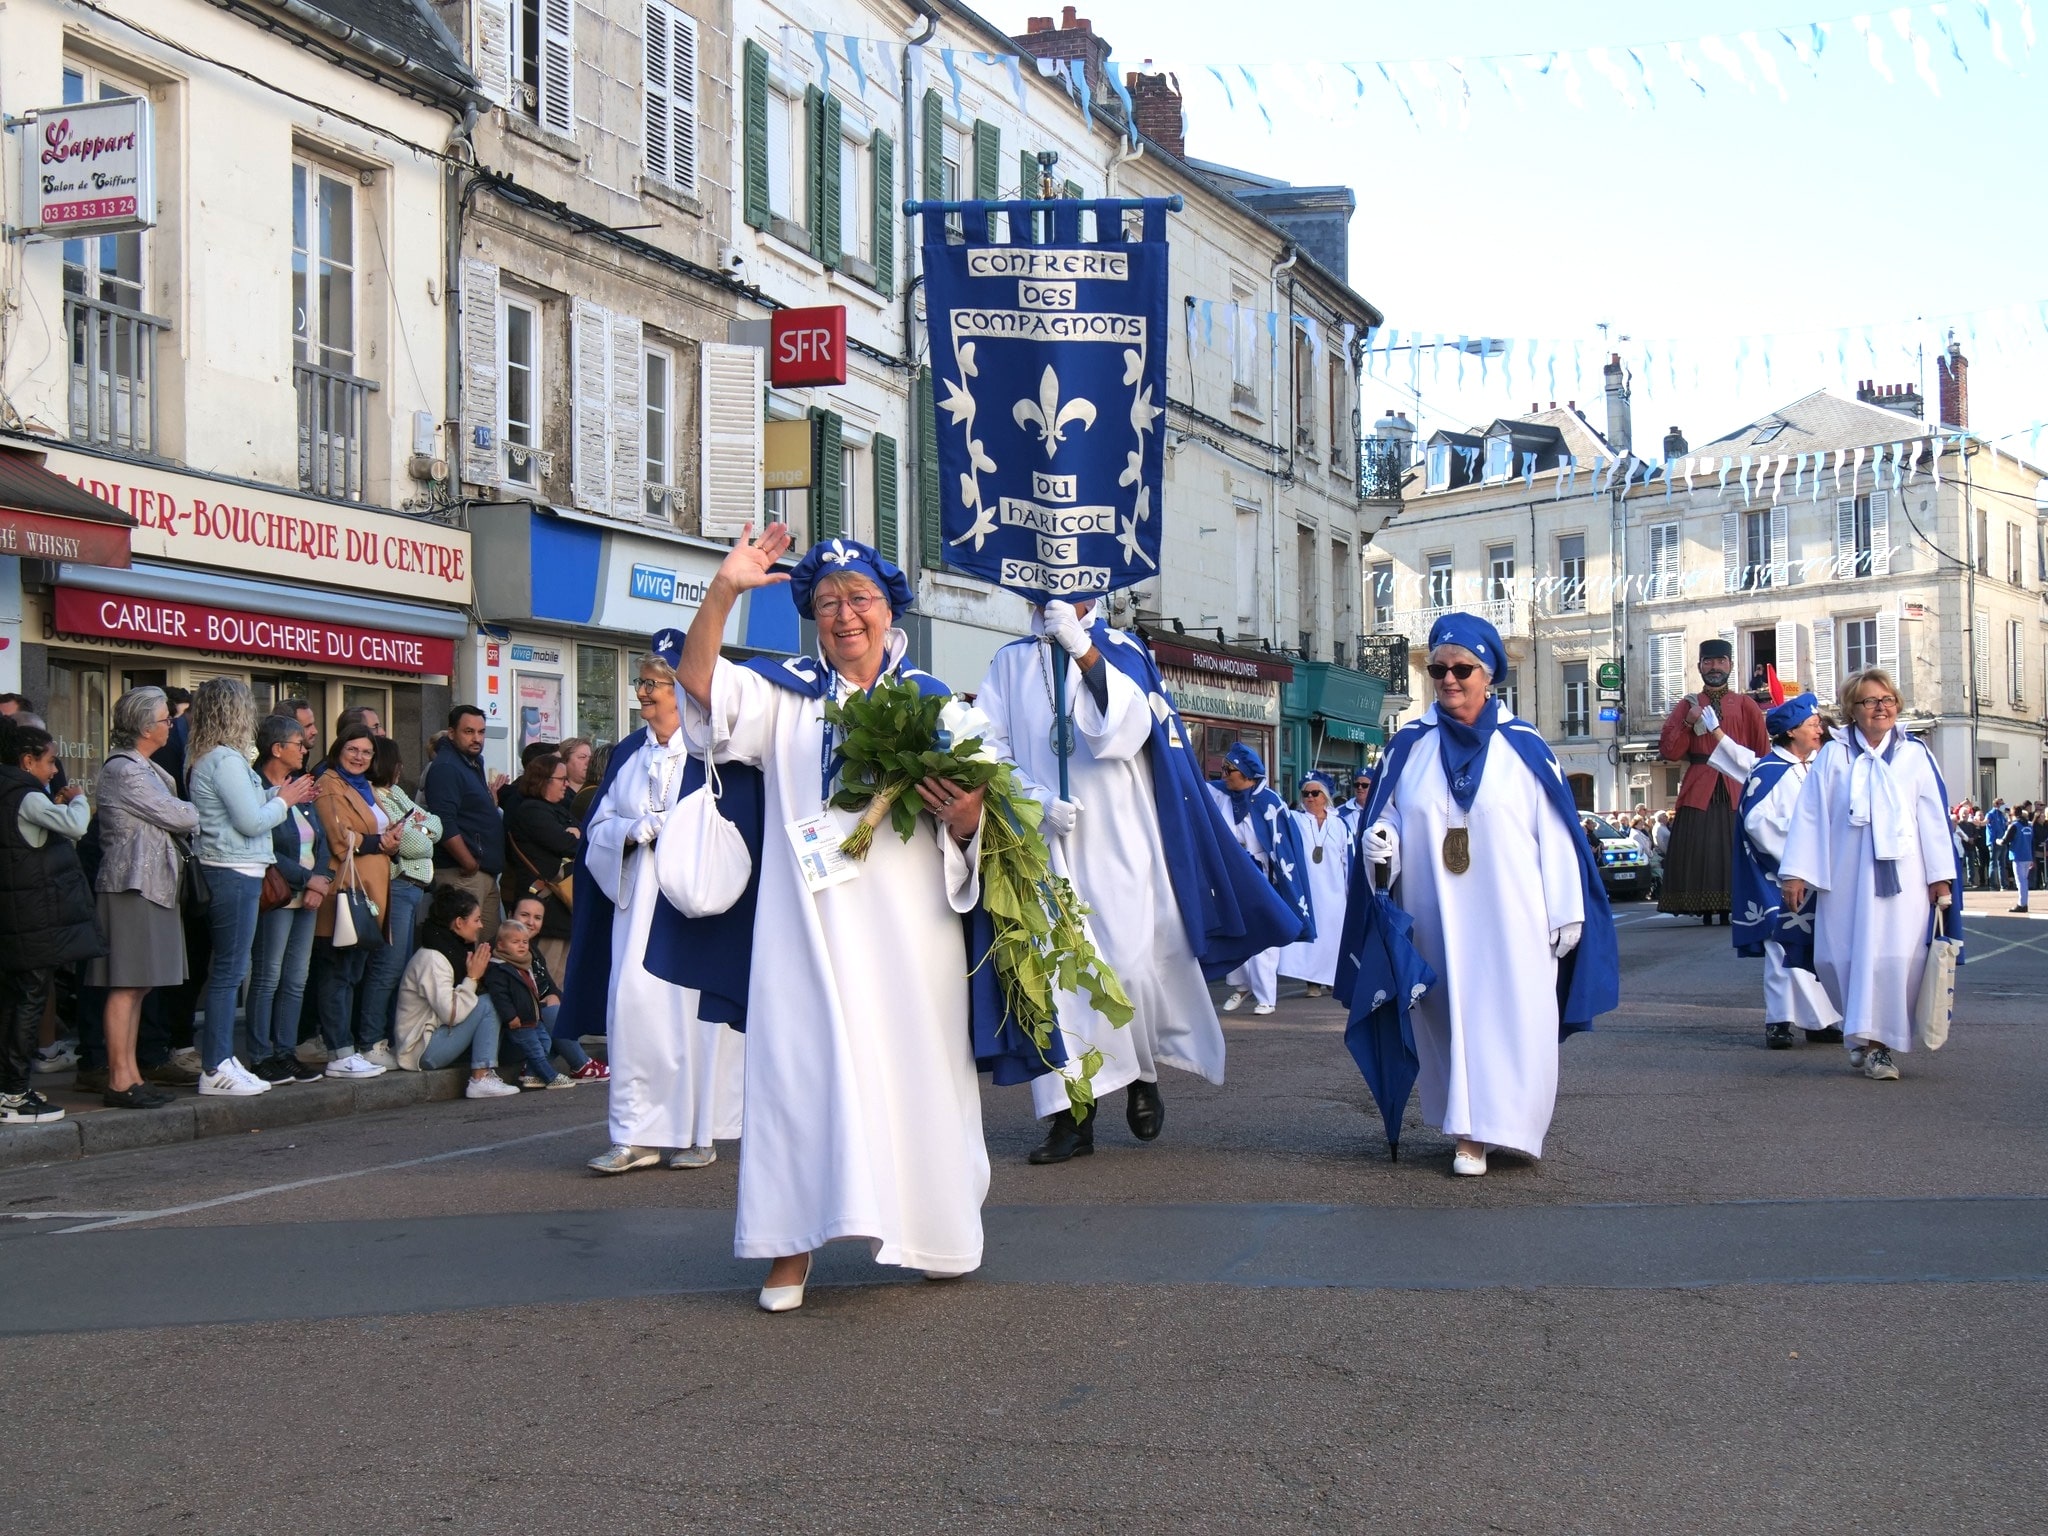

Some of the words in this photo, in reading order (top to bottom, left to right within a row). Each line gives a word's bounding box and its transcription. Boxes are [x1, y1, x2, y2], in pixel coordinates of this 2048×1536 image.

[42, 175, 74, 195] Salon
[78, 180, 89, 190] de
[44, 207, 59, 220] 03
[63, 205, 77, 218] 23
[82, 203, 96, 216] 53
[101, 201, 115, 214] 13
[120, 199, 134, 212] 24
[1023, 284, 1072, 306] DES
[954, 311, 1142, 336] COMPAGNONS
[779, 328, 831, 363] SFR
[764, 469, 803, 485] ange
[1036, 477, 1073, 498] DU
[25, 530, 81, 558] WHISKY
[1041, 538, 1071, 559] DE
[345, 528, 379, 565] DU
[384, 536, 465, 582] CENTRE
[636, 570, 672, 597] vivre
[676, 581, 708, 603] mob
[1005, 562, 1108, 591] SOISSONS
[101, 601, 187, 638] CARLIER
[208, 615, 321, 654] BOUCHERIE
[327, 631, 353, 658] DU
[360, 636, 424, 666] CENTRE
[488, 649, 498, 660] SFR
[513, 647, 531, 659] vivre
[532, 650, 558, 662] mobile
[1192, 653, 1219, 670] FASHION
